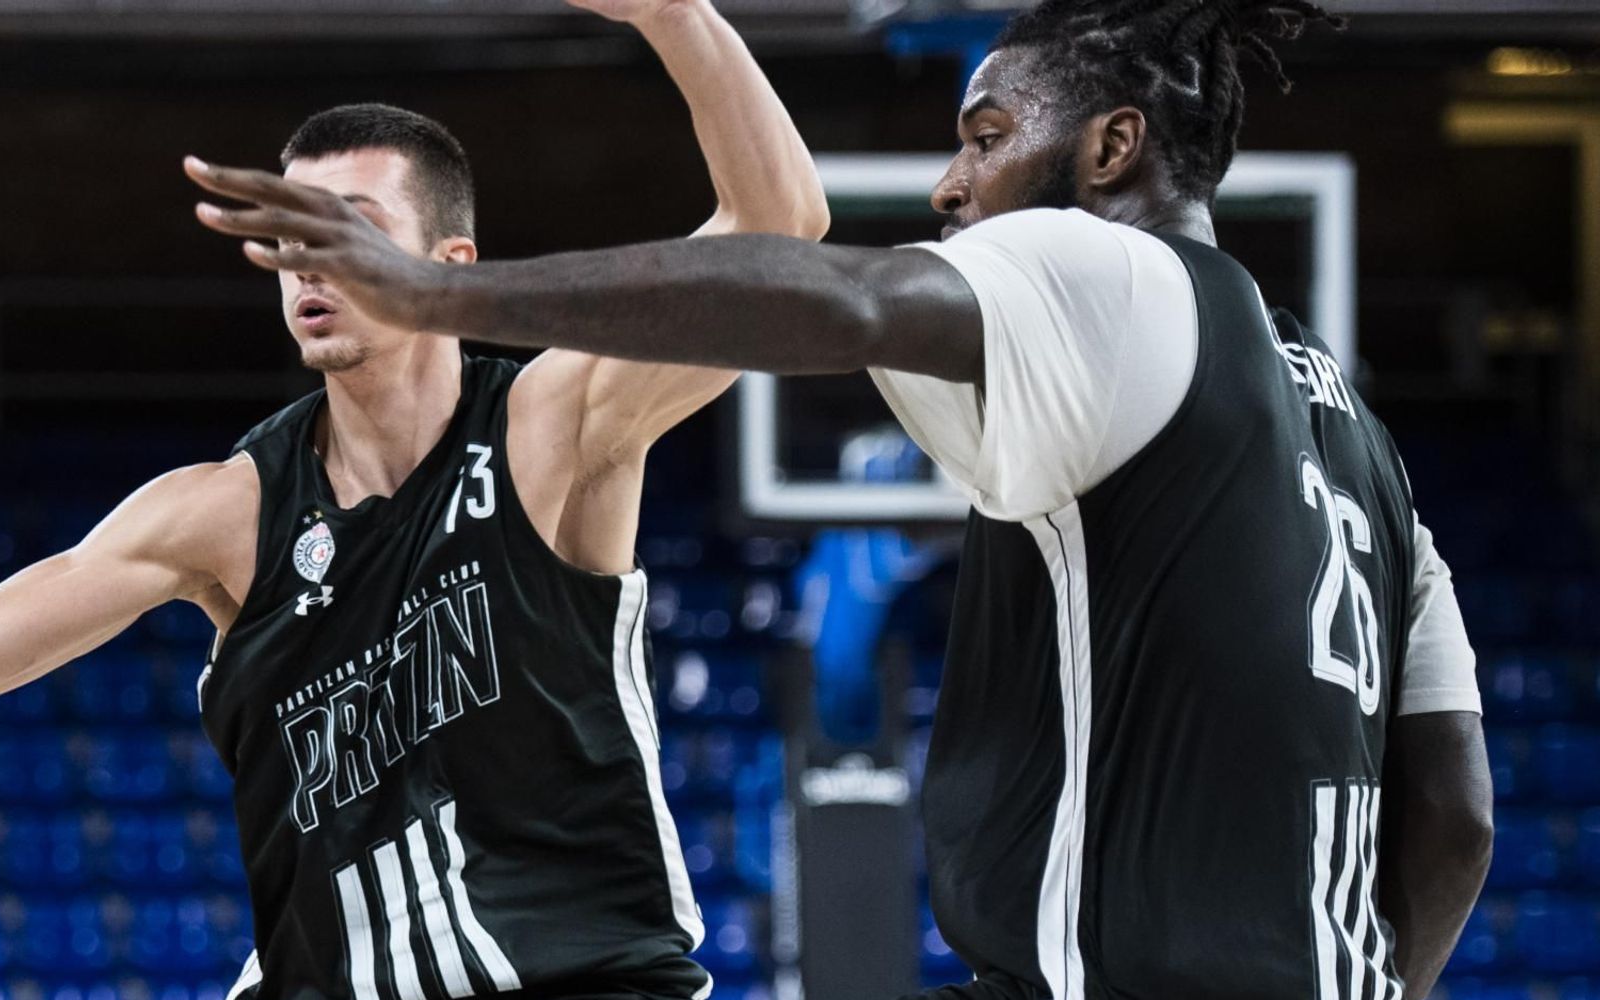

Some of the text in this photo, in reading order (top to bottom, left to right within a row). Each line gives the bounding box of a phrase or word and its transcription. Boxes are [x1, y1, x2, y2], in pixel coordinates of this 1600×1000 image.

[275, 660, 356, 718] PARTIZAN
[440, 560, 480, 589] CLUB
[1301, 453, 1381, 716] 26
